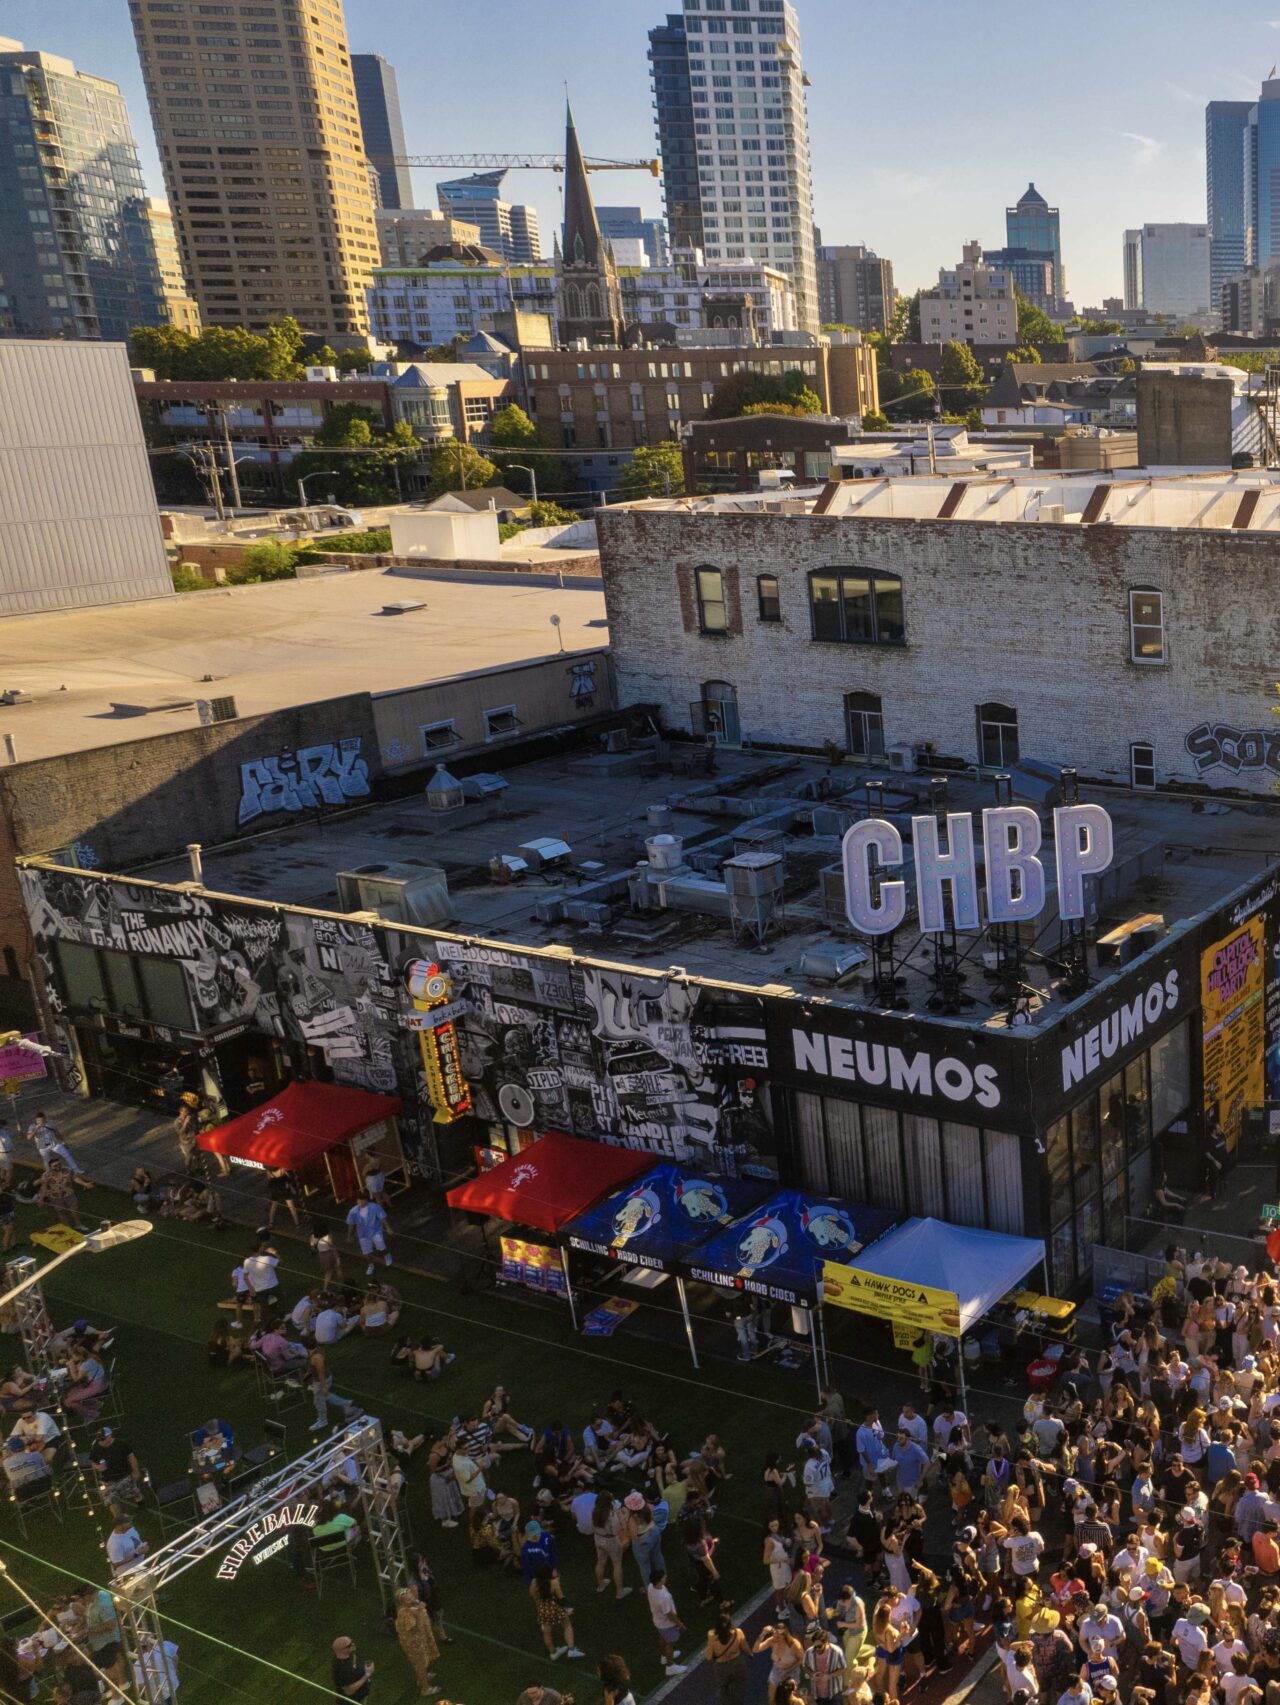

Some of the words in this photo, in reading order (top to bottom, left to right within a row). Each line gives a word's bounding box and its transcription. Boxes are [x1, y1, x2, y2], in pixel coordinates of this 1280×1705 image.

[842, 804, 1113, 936] CHBP
[121, 912, 147, 931] THE
[128, 918, 208, 957] RUNAWAY
[1061, 968, 1179, 1092] NEUMOS
[439, 1032, 461, 1105] CHICKEN
[792, 1028, 1001, 1108] NEUMOS
[569, 1236, 609, 1255] SCHILLING
[616, 1249, 638, 1264] HARD
[640, 1255, 664, 1270] CIDER
[691, 1268, 735, 1287] SCHILLING
[744, 1279, 768, 1295] HARD
[769, 1286, 796, 1303] CIDER
[864, 1278, 891, 1292] HAWK
[892, 1285, 916, 1299] DOGS
[217, 1503, 319, 1580] FIREBALL
[253, 1534, 290, 1566] WHISKY
